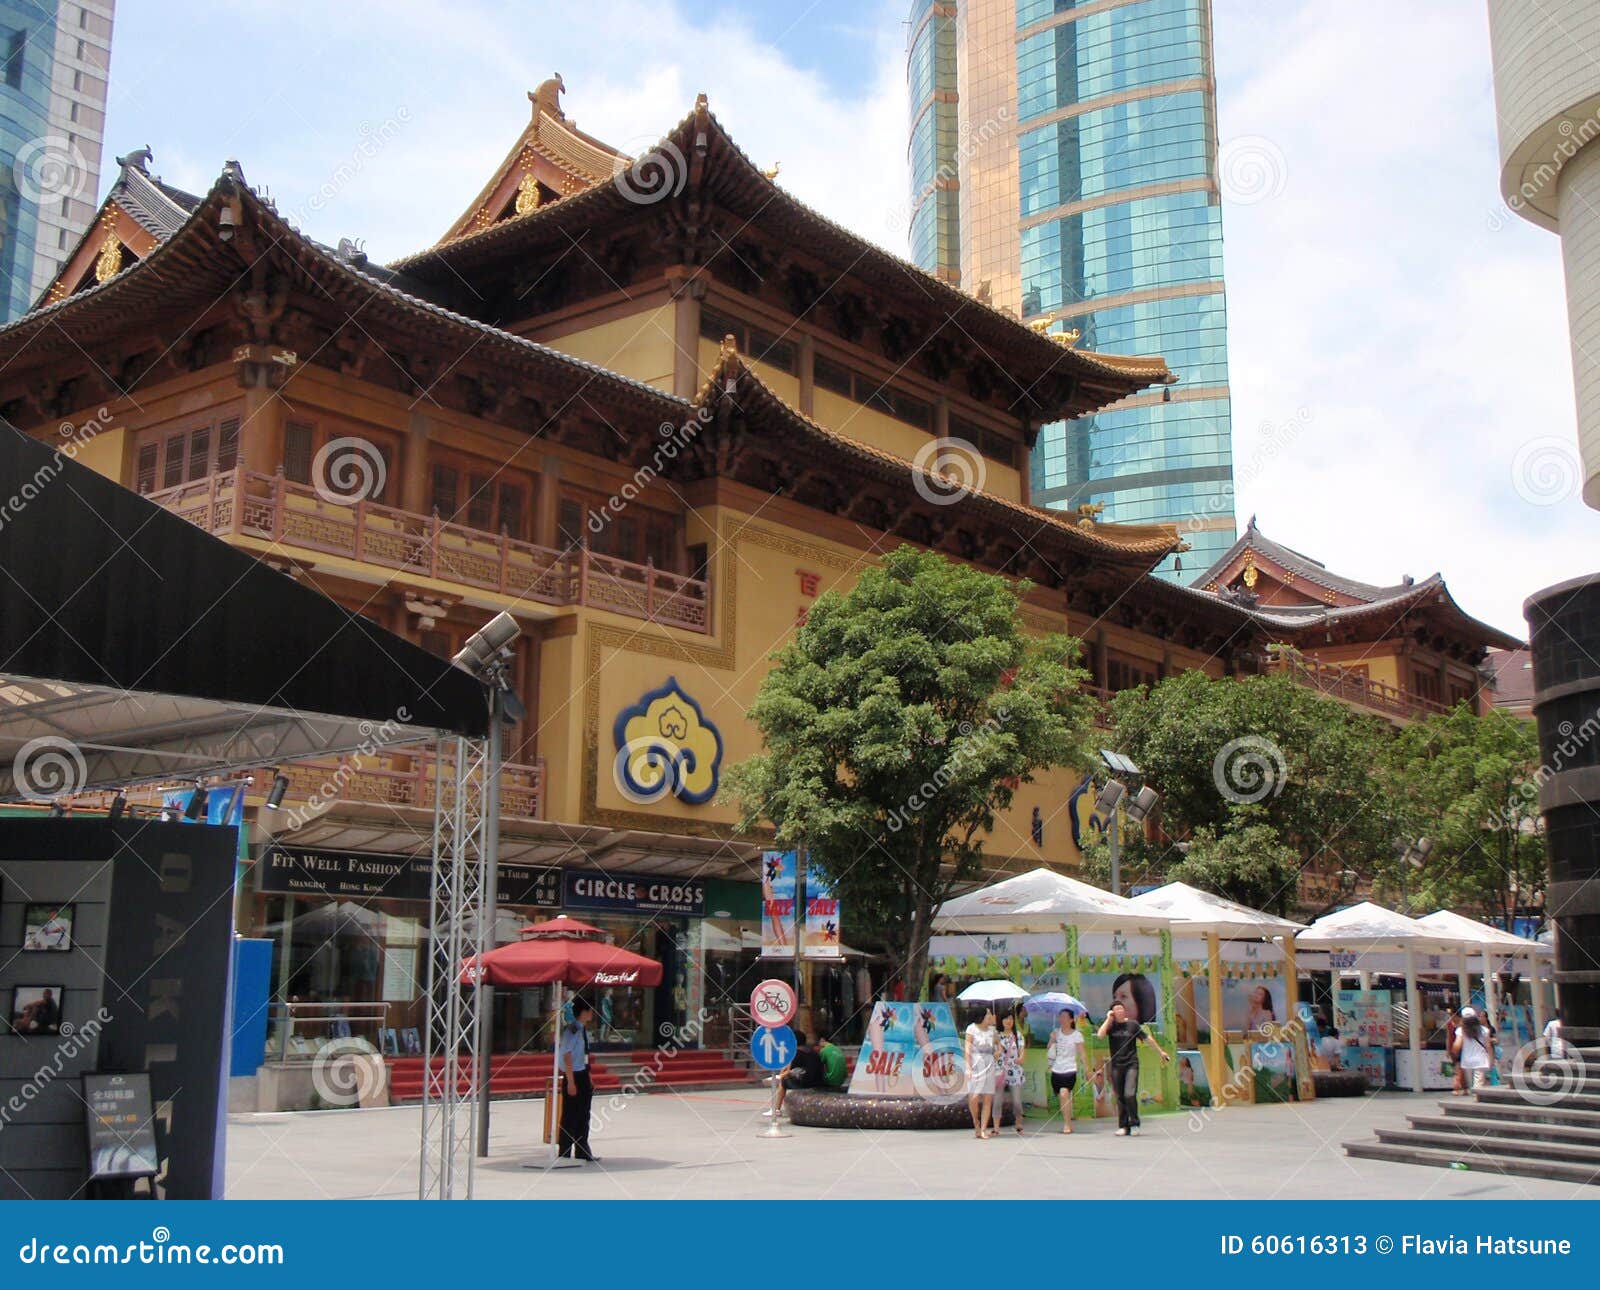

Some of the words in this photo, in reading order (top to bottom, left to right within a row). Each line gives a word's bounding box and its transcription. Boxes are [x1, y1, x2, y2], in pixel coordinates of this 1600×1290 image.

[272, 853, 295, 867] FIT
[303, 855, 341, 871] WELL
[348, 858, 401, 875] FASHION
[288, 879, 326, 889] SHANGHAI
[340, 882, 360, 890] HONG
[363, 883, 383, 892] KONG
[575, 879, 636, 900] CIRCLE
[649, 884, 704, 903] CROSS
[765, 898, 792, 916] SALE
[808, 898, 837, 916] SALE
[866, 1050, 904, 1076] SALE
